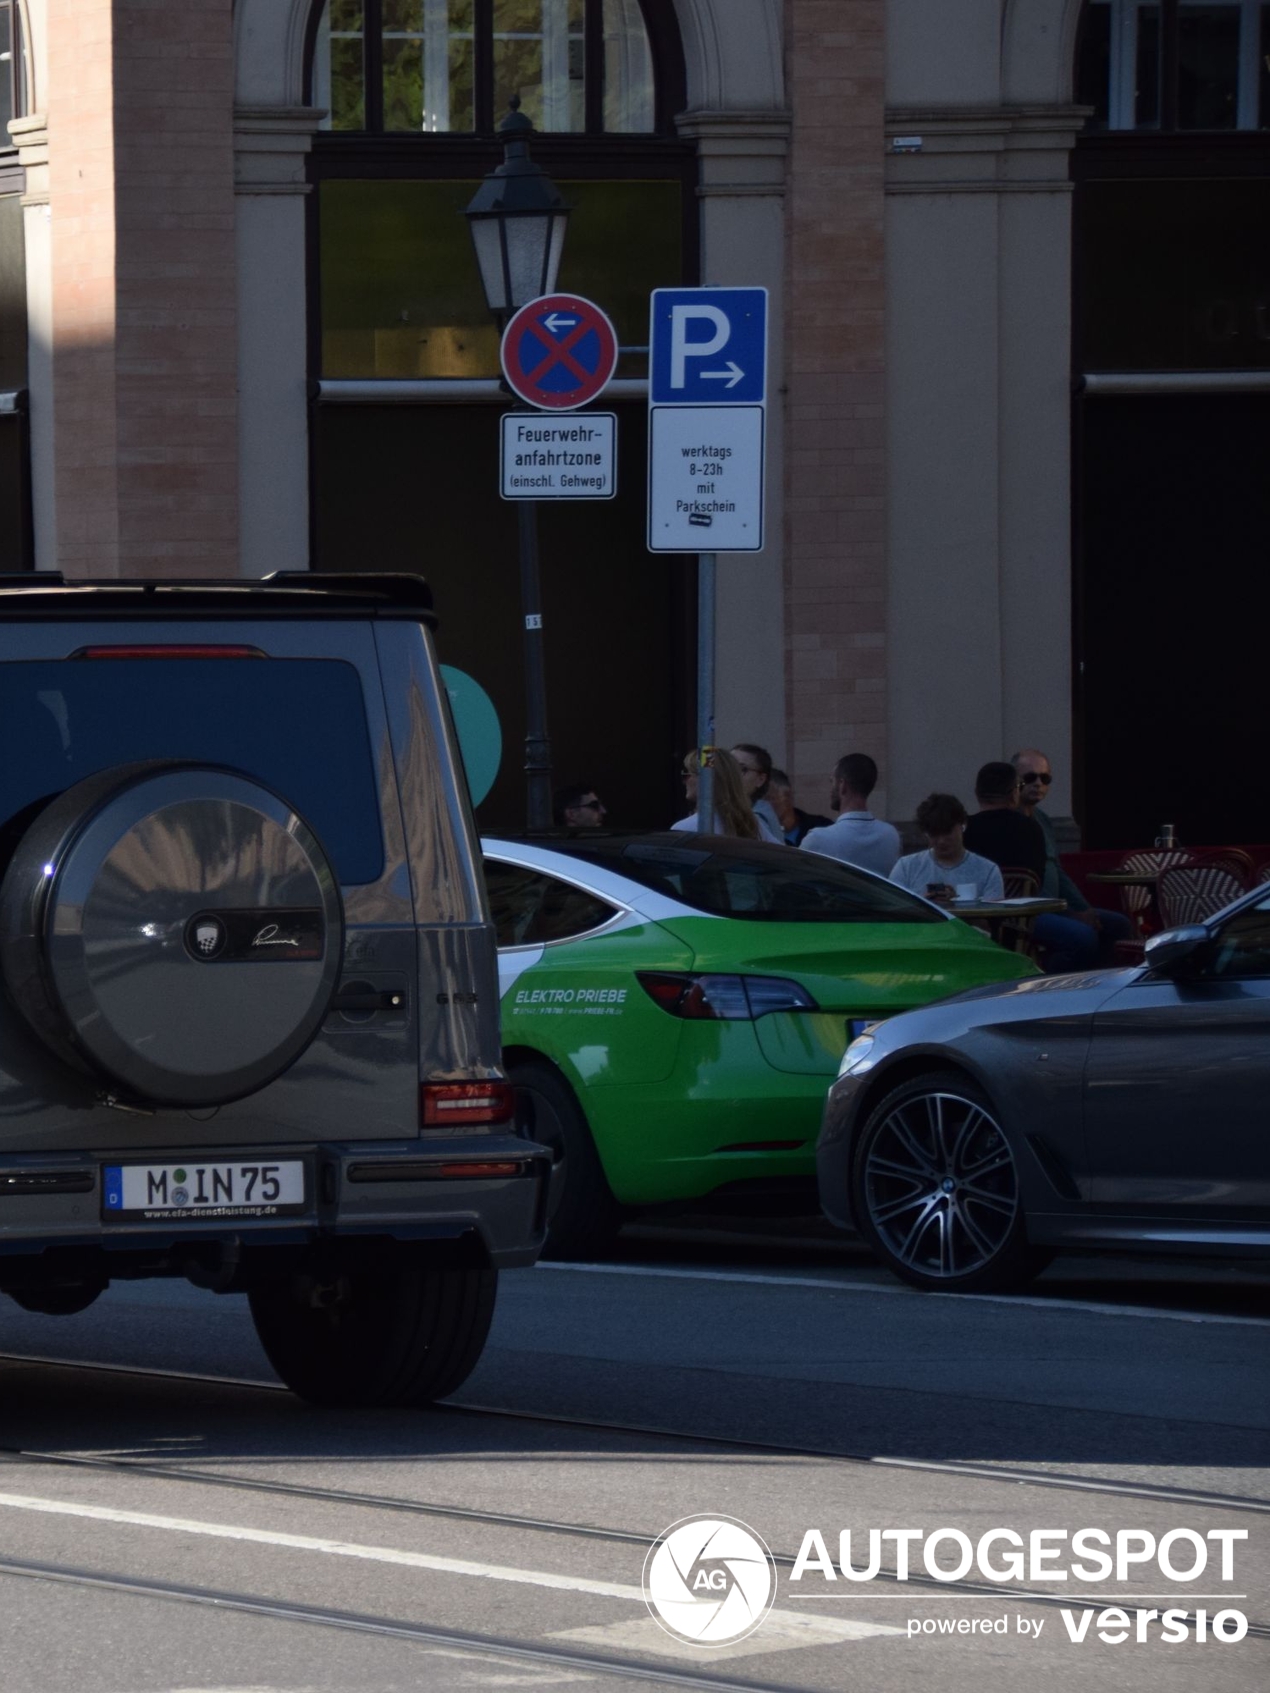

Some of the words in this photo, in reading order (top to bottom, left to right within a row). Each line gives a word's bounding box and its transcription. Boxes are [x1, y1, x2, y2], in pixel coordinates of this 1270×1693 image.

[670, 304, 731, 390] P
[517, 425, 602, 442] Feuerwehr-
[515, 450, 602, 466] anfahrtzone
[681, 444, 732, 461] werktags
[689, 462, 723, 477] 8-23h
[510, 474, 555, 489] (einschl.
[560, 474, 606, 490] Gehweg)
[697, 481, 715, 494] mit
[676, 499, 735, 513] Parkschein
[515, 989, 574, 1003] ELEKTRO
[576, 989, 627, 1003] PRIEBE
[147, 1170, 167, 1204] M
[193, 1168, 233, 1203] IN
[240, 1167, 280, 1201] 75
[144, 1206, 277, 1218] www.efa-dienstleistung.de
